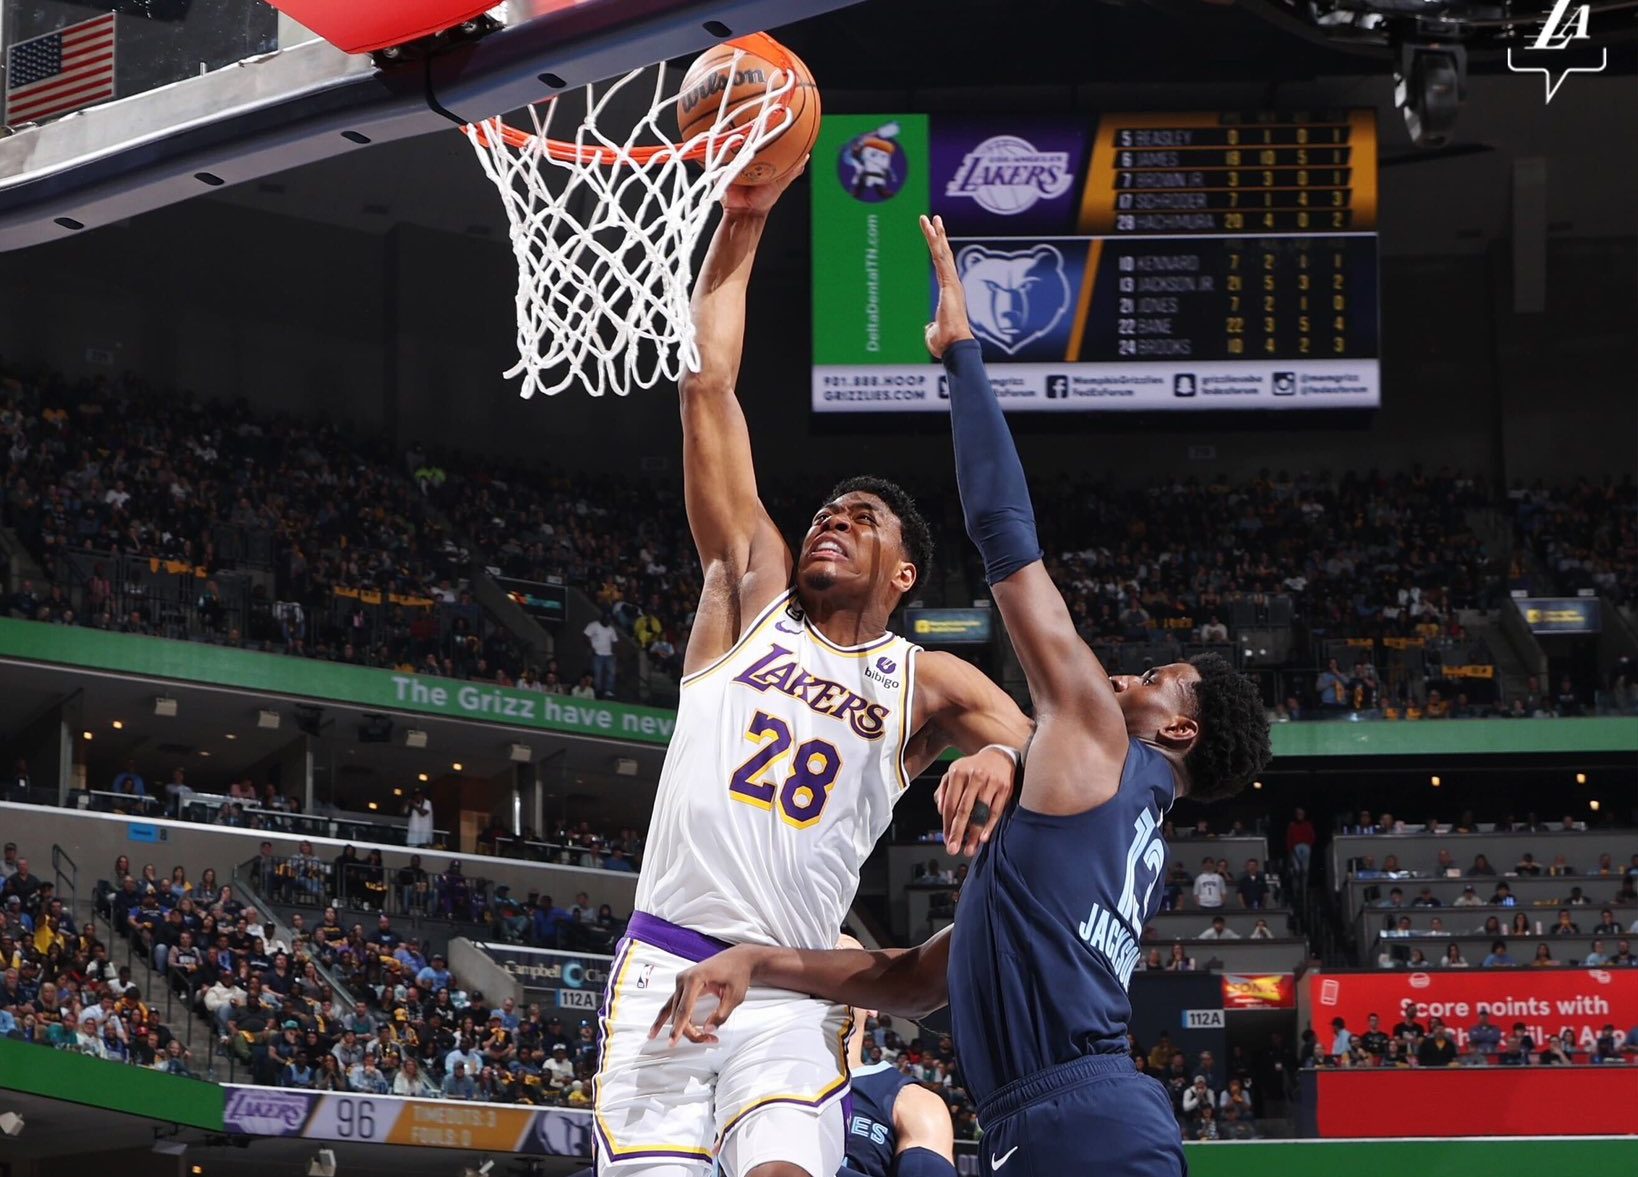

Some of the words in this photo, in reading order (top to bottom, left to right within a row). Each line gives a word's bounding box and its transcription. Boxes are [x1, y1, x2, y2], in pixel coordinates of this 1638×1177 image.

[1121, 130, 1132, 146] 5
[1135, 130, 1192, 146] BEASLEY
[1135, 151, 1179, 166] JAMES
[957, 156, 1063, 194] LAKERS
[866, 214, 879, 351] DeltaDentalTN.com
[1226, 317, 1244, 332] 22
[823, 390, 926, 401] GRIZZLIES.COM
[864, 666, 899, 690] bibigo
[392, 676, 448, 706] The
[457, 687, 535, 719] Grizz
[544, 696, 613, 728] have
[732, 643, 893, 742] LAKERS
[729, 708, 844, 830] 28
[1079, 902, 1141, 994] JACKSO
[504, 960, 561, 979] Campbell
[562, 992, 593, 1007] 112A
[1400, 998, 1469, 1017] Score
[1557, 995, 1609, 1015] with
[1190, 1012, 1222, 1025] 112A
[227, 1094, 303, 1127] LAKERS
[336, 1099, 376, 1139] 96
